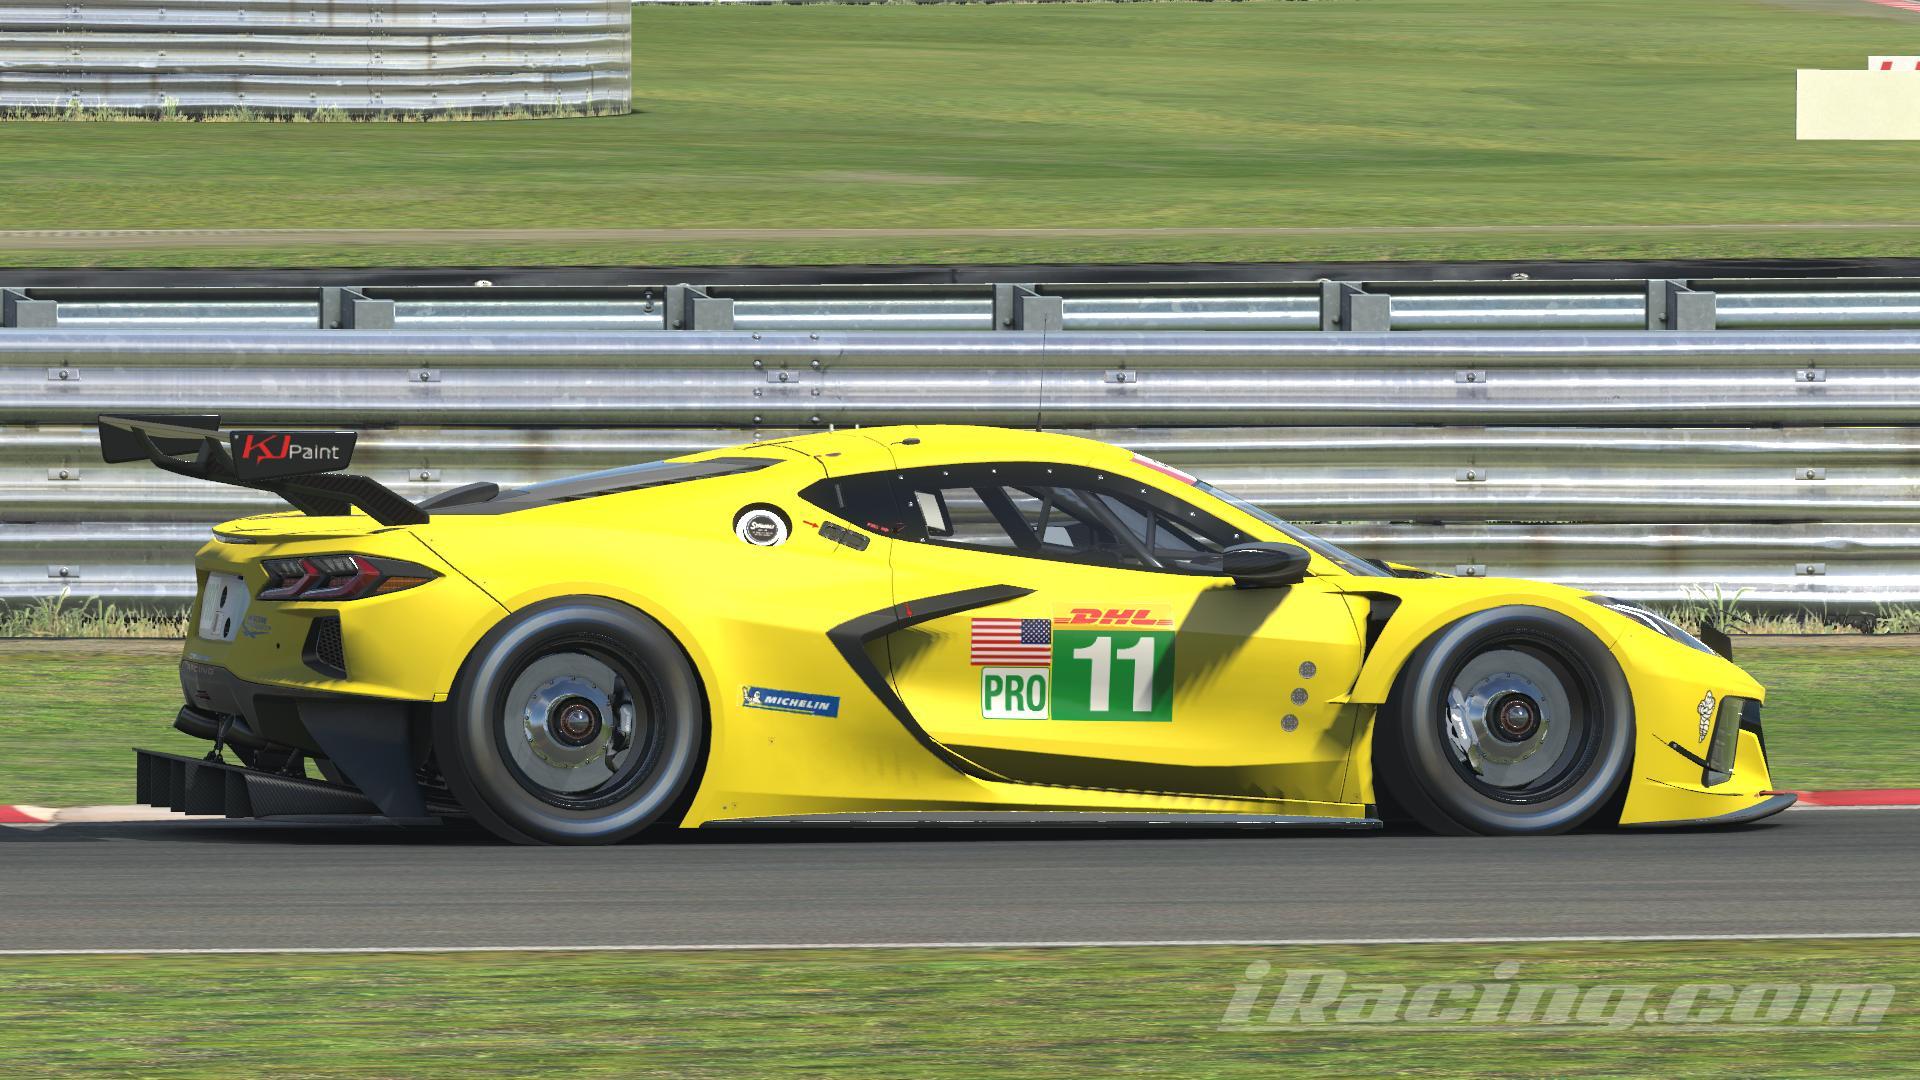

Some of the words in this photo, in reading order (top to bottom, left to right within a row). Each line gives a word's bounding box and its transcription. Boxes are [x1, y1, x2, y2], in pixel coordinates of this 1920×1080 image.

[1070, 608, 1158, 625] DHL
[1073, 636, 1155, 712] 11
[764, 695, 830, 710] MICHELIN
[984, 674, 1046, 712] PRO
